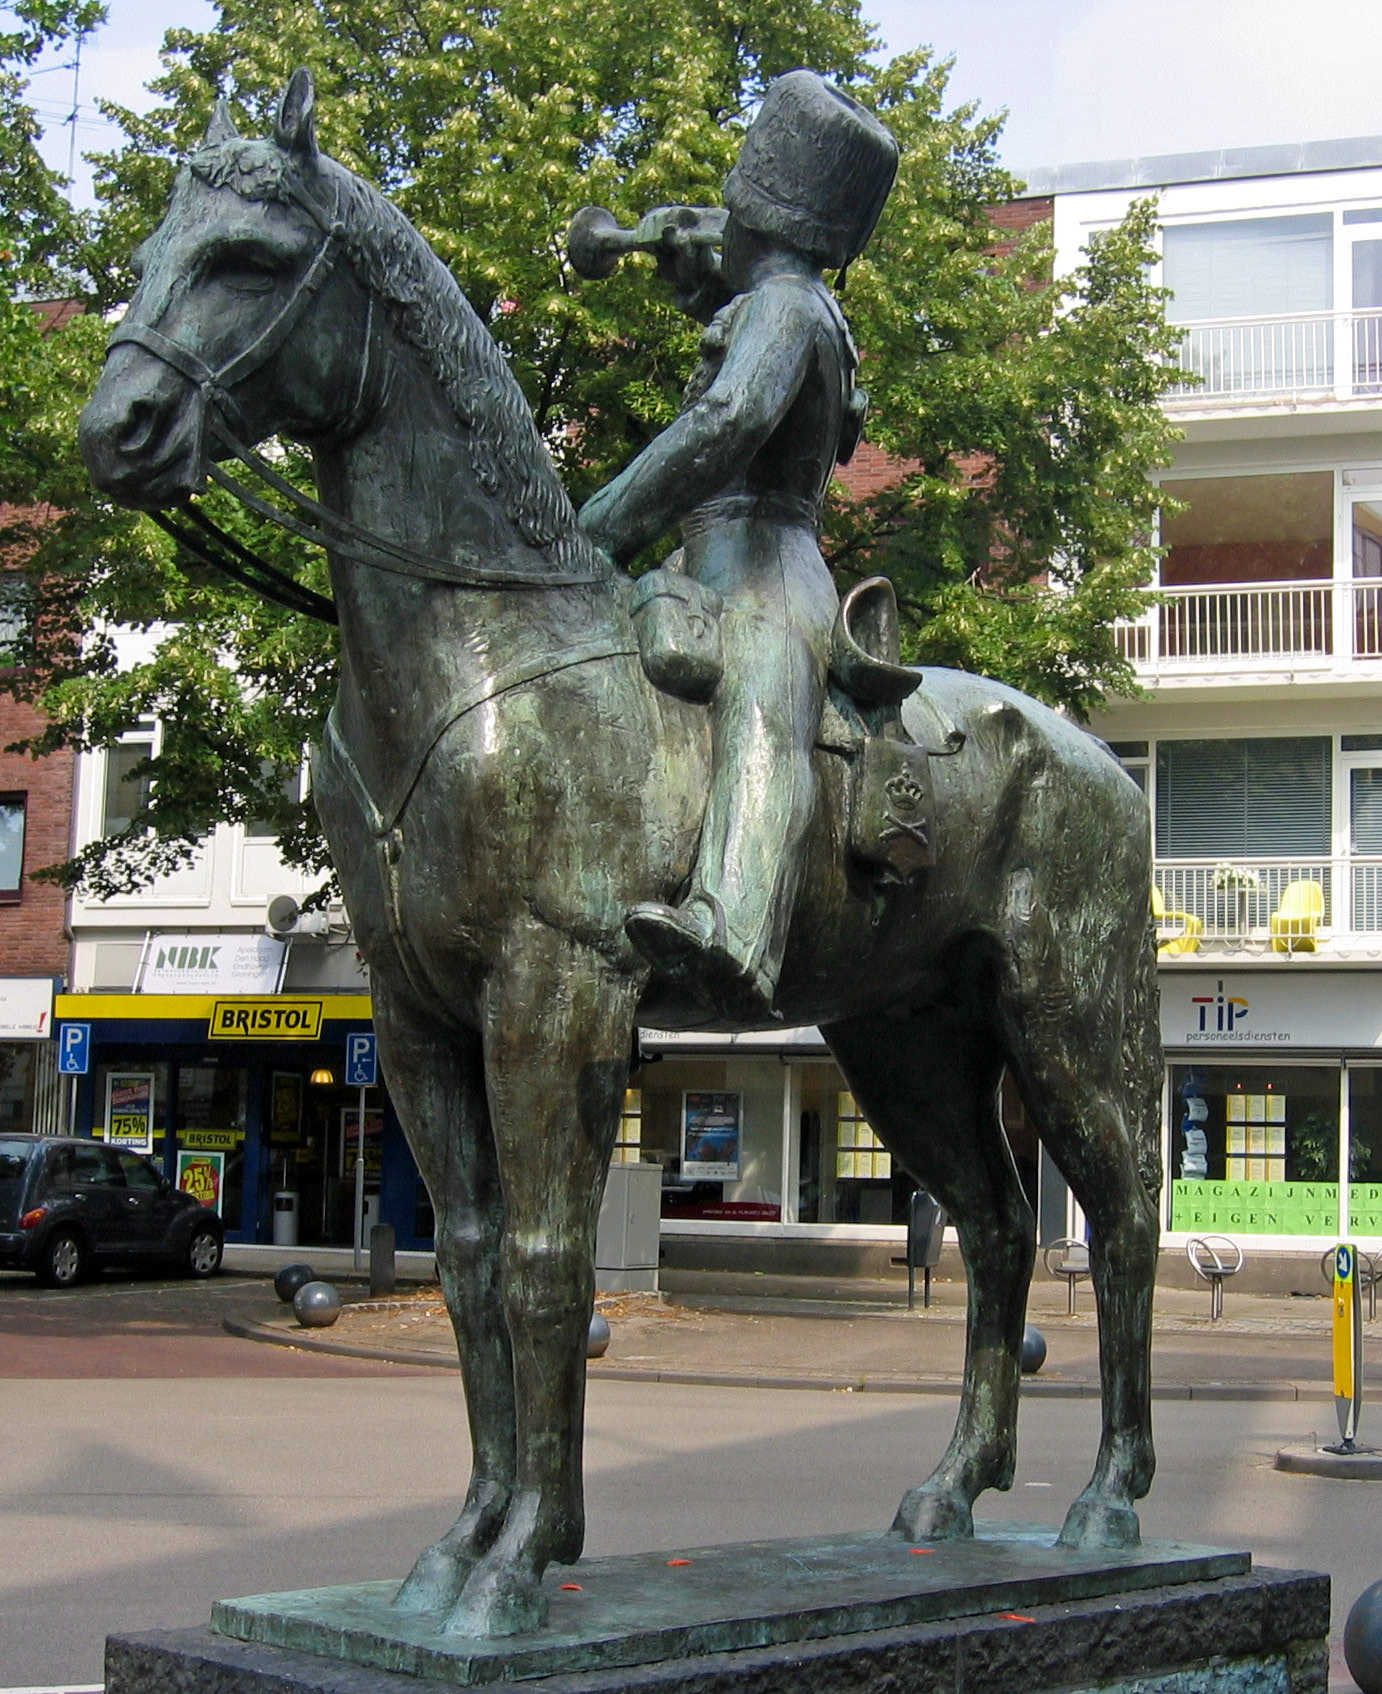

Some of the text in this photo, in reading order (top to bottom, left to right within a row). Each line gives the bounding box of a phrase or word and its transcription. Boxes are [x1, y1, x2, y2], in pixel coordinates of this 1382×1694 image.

[221, 1009, 312, 1036] BRISTOL
[66, 1028, 83, 1052] P
[1186, 1030, 1291, 1043] personeelsdiensten
[353, 1038, 370, 1063] P
[114, 1117, 146, 1136] 75%
[188, 1133, 232, 1145] BRISTOL
[183, 1165, 214, 1194] 25%
[1194, 1211, 1278, 1225] EIGEN
